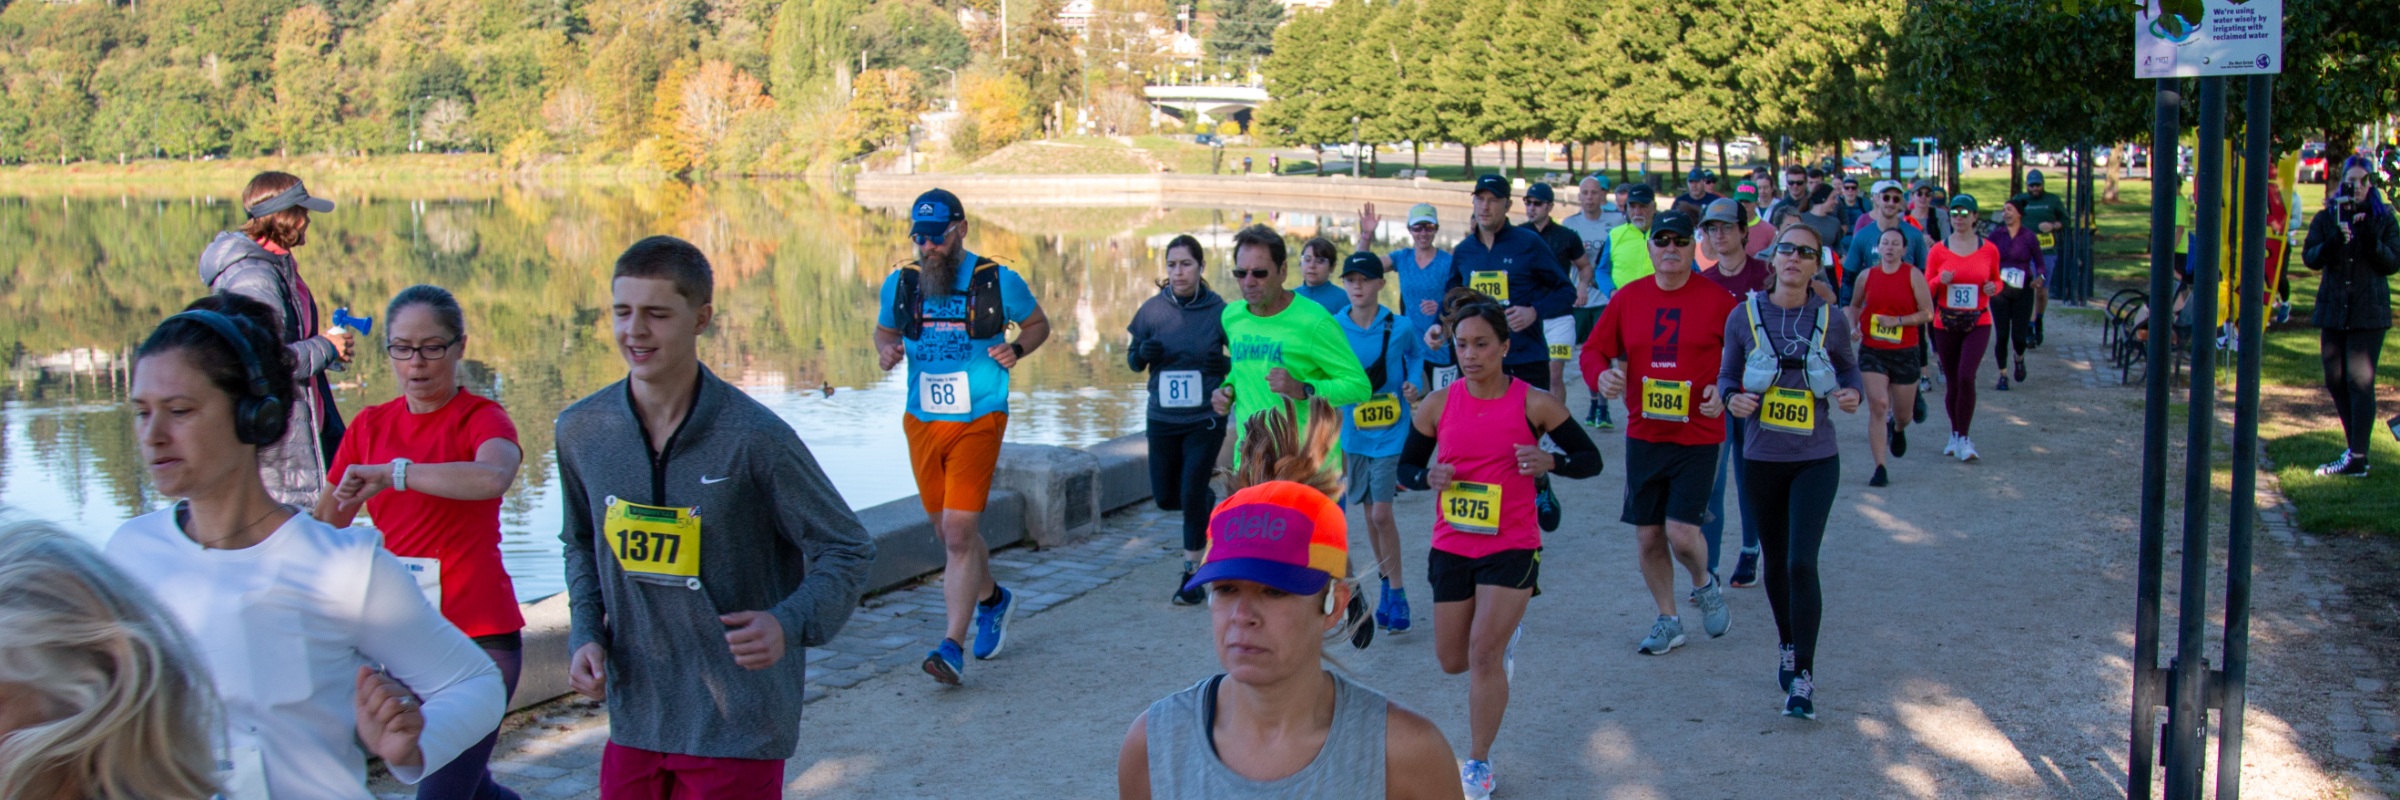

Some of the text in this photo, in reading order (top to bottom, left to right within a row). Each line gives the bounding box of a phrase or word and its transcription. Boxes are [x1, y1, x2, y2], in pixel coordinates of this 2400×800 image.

[2234, 15, 2257, 23] wisely
[2258, 14, 2267, 22] by
[2235, 7, 2255, 15] using
[2213, 23, 2263, 32] irrigating with
[2213, 32, 2247, 40] reclaimed
[1955, 289, 1970, 304] 93
[1550, 344, 1568, 356] 385
[1442, 371, 1456, 388] 67
[931, 383, 955, 405] 68
[1170, 379, 1188, 399] 81
[1648, 392, 1683, 410] 1384
[1360, 405, 1394, 422] 1376
[1768, 401, 1808, 423] 1369
[1449, 497, 1490, 520] 1375
[1224, 511, 1287, 542] ciele
[616, 529, 681, 564] 1377
